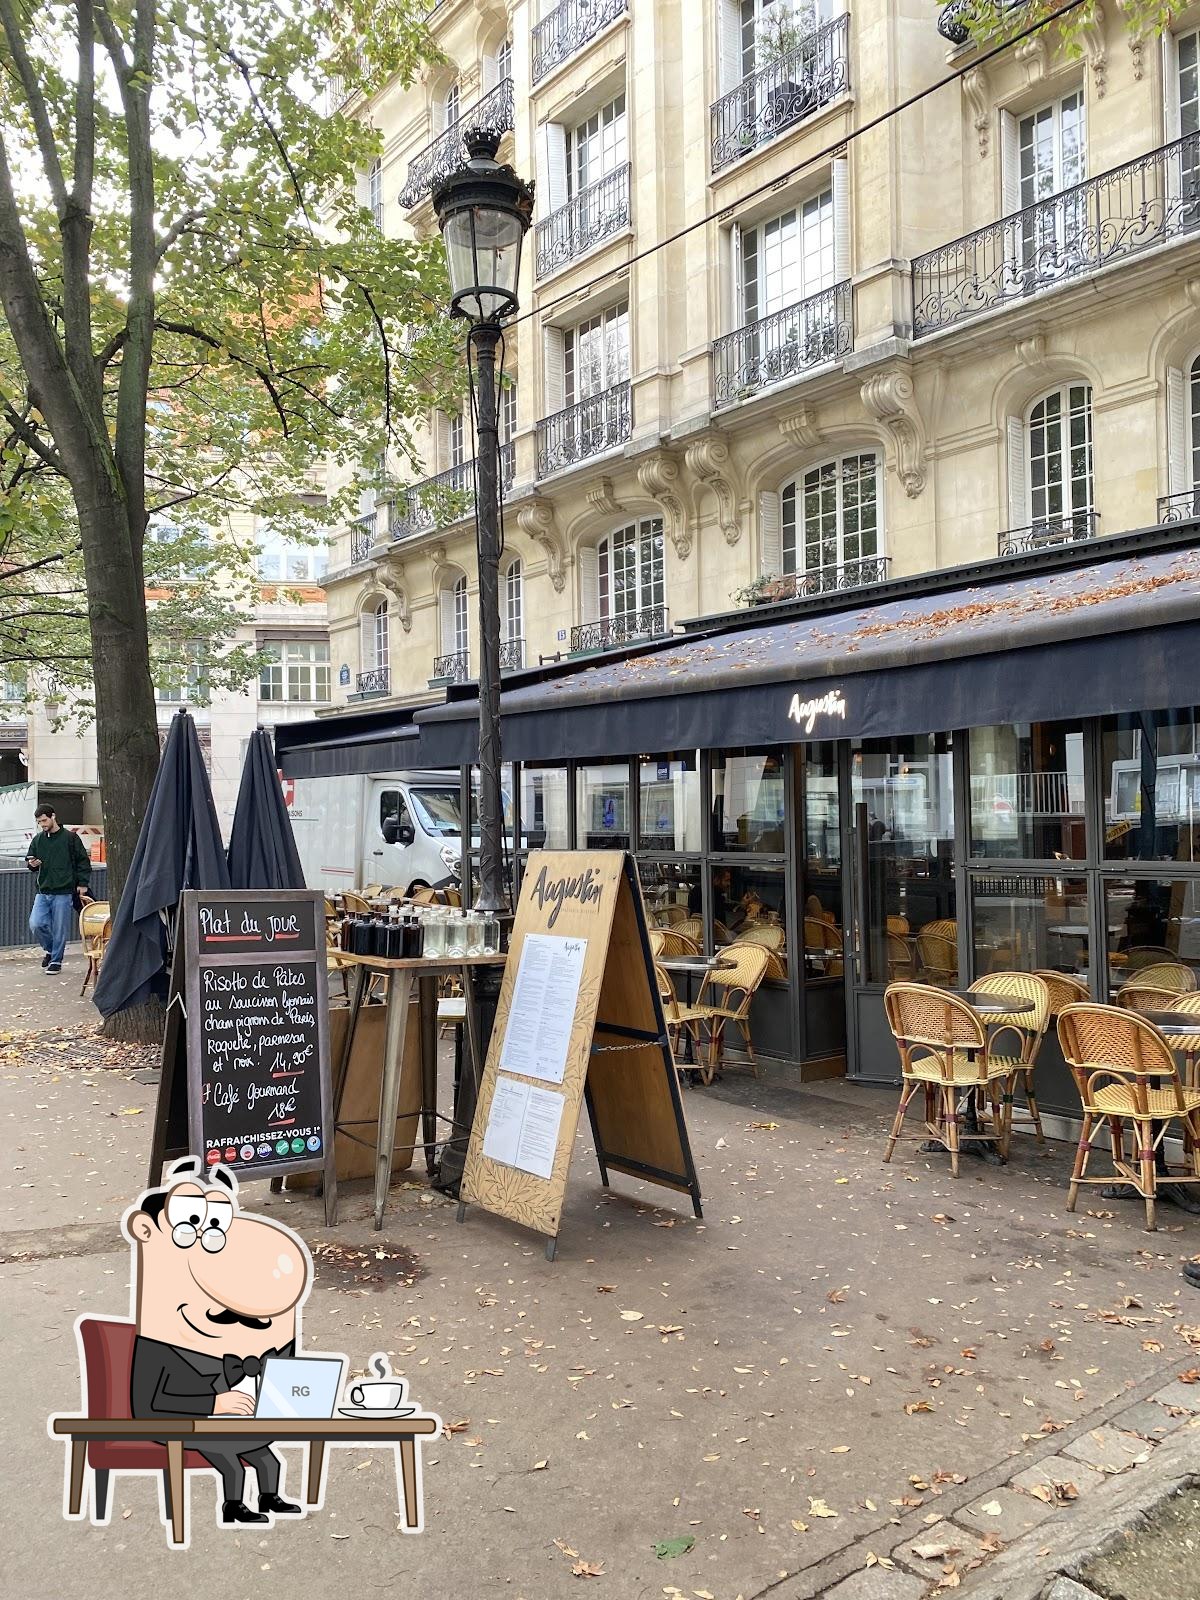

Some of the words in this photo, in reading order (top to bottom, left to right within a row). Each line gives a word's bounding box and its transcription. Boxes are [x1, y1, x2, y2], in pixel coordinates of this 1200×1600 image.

[788, 690, 845, 734] Augustin
[530, 866, 603, 928] Augustin
[200, 908, 231, 934] Plat
[241, 910, 262, 933] du
[204, 969, 247, 992] Risotto
[252, 971, 270, 989] de
[273, 966, 305, 986] Pâtes
[205, 999, 222, 1011] au
[229, 994, 278, 1010] saucisson
[271, 1012, 285, 1025] de
[260, 1033, 305, 1056] parmesan
[213, 1056, 223, 1072] et
[214, 1082, 240, 1113] Café
[268, 1097, 296, 1120] 18€
[206, 1128, 311, 1149] RAFRAICHISSEZ-VOUS
